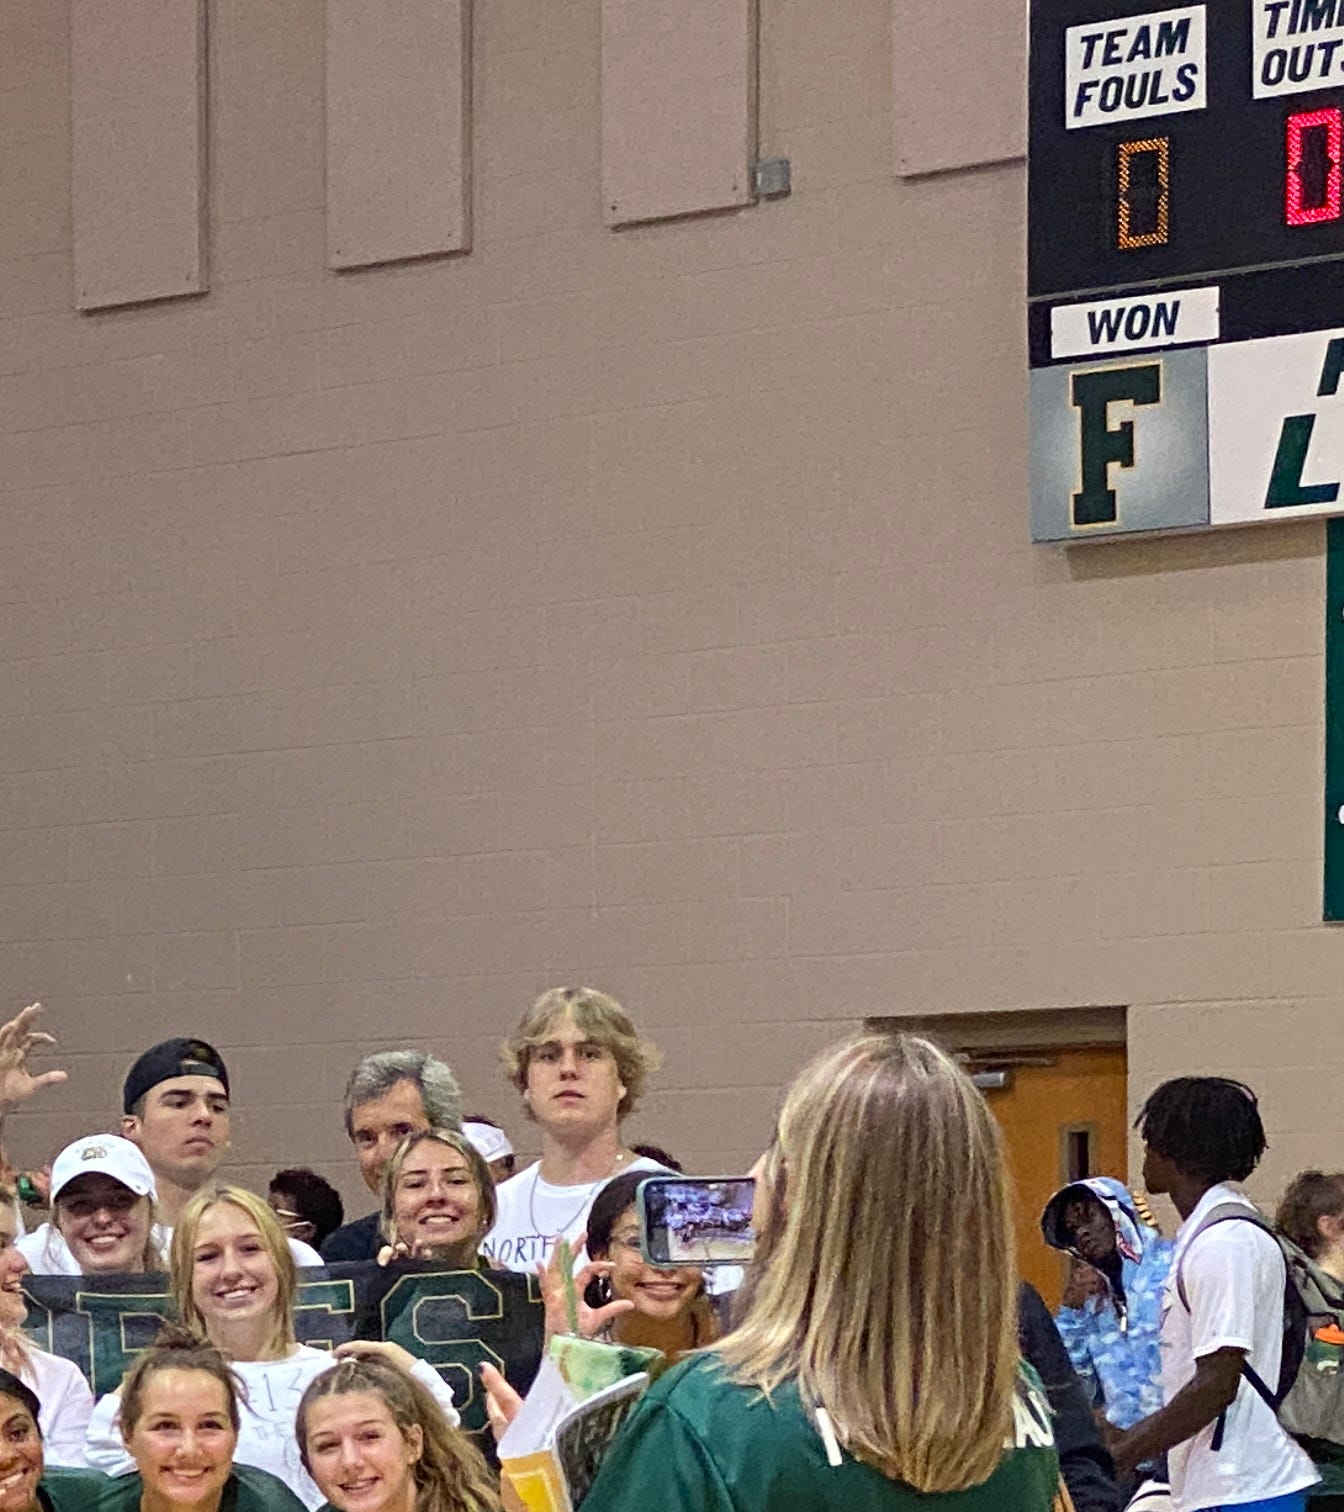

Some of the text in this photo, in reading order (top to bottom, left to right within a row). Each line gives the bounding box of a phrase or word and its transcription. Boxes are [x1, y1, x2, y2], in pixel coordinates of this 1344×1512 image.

[1079, 17, 1191, 70] TEAM
[1261, 38, 1344, 86] OUT
[1073, 62, 1198, 118] FOULS
[1118, 136, 1169, 250] 0
[1286, 107, 1342, 228] 0
[1087, 301, 1180, 345] WON
[1070, 360, 1164, 529] F
